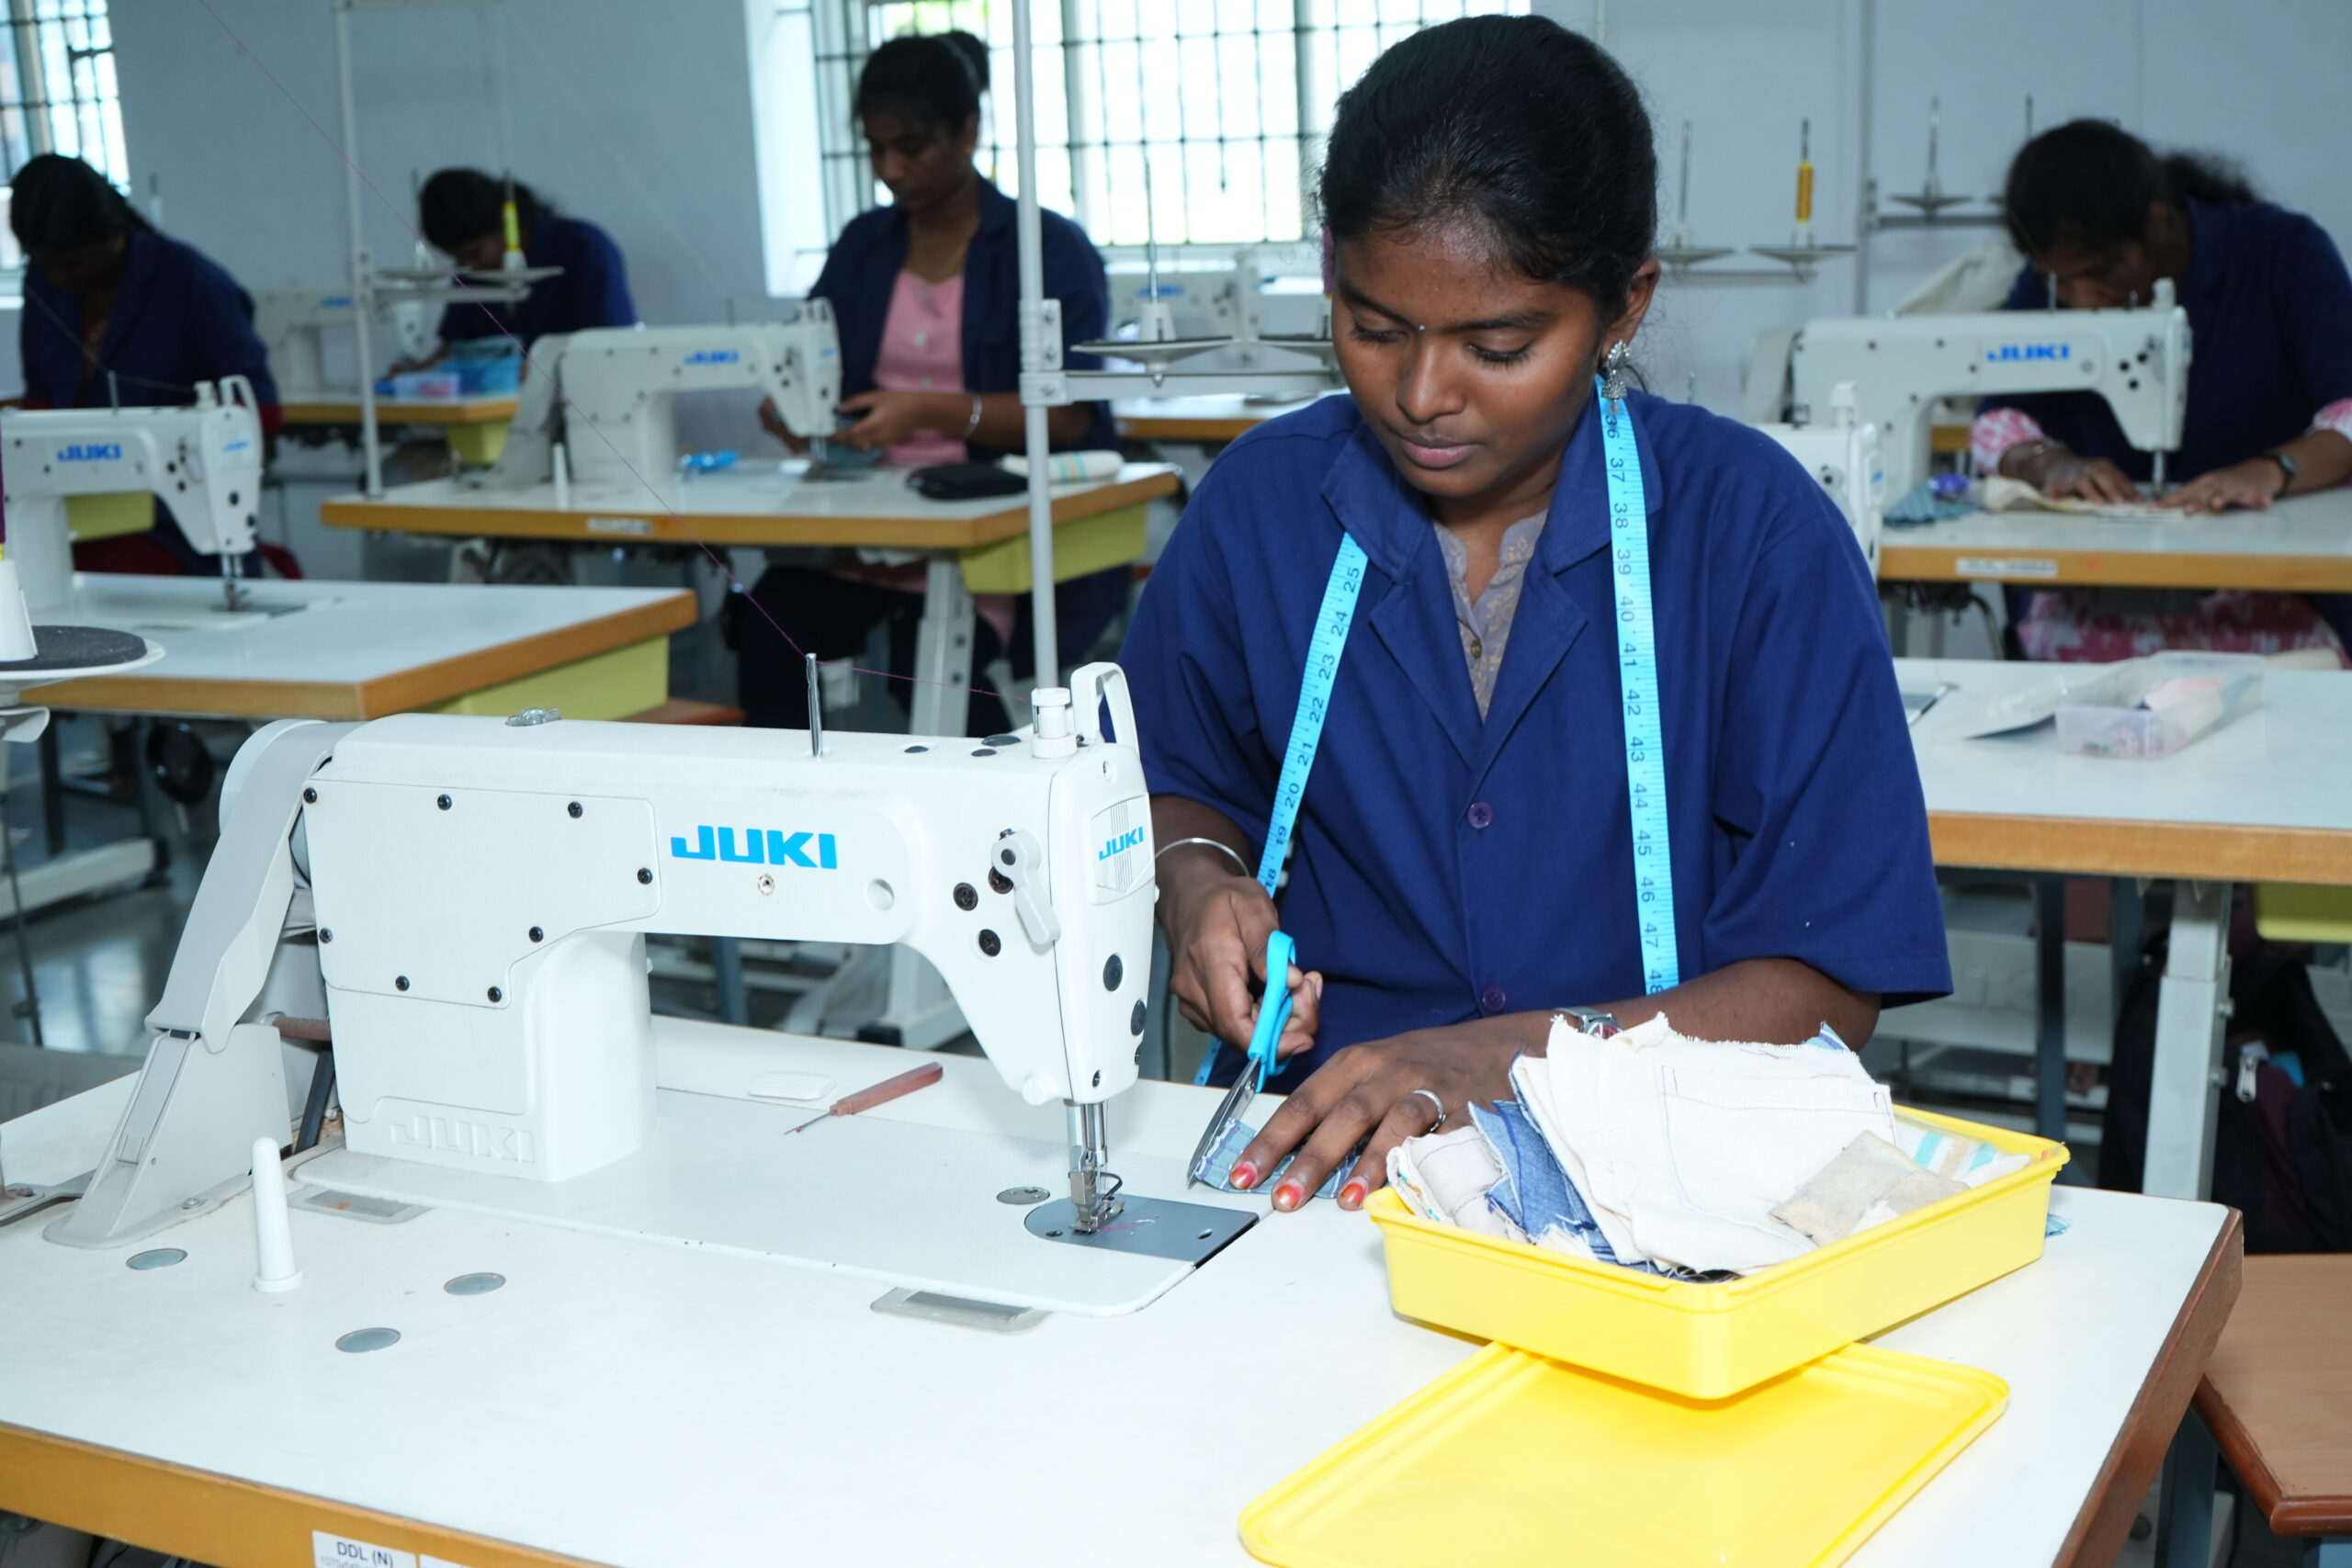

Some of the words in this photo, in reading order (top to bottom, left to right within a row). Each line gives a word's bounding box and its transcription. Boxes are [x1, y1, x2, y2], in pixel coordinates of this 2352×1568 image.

[1985, 343, 2070, 362] JUKI
[1605, 414, 1620, 439] 36
[57, 443, 121, 461] JUKI
[1610, 457, 1625, 483] 37
[1614, 502, 1629, 529] 38
[1617, 549, 1632, 576] 39
[1620, 595, 1634, 623] 40
[1623, 643, 1637, 667] 41
[1627, 690, 1641, 716] 42
[1265, 869, 1276, 888] 18
[1275, 826, 1286, 845] 19
[1285, 783, 1300, 808] 20
[1297, 742, 1313, 767] 21
[1309, 697, 1324, 724] 22
[1318, 654, 1335, 681] 23
[1331, 611, 1348, 637] 24
[1343, 568, 1360, 593] 25
[1630, 737, 1645, 762] 43
[1634, 783, 1648, 809] 44
[671, 825, 837, 869] JUKI
[1099, 826, 1144, 861] JUKI
[1637, 829, 1652, 856] 45
[1640, 876, 1656, 903] 46
[1644, 922, 1659, 948] 47
[1648, 969, 1664, 995] 48
[391, 1114, 536, 1164] JUKI
[336, 1540, 368, 1561] DDL
[372, 1550, 394, 1568] (N)
